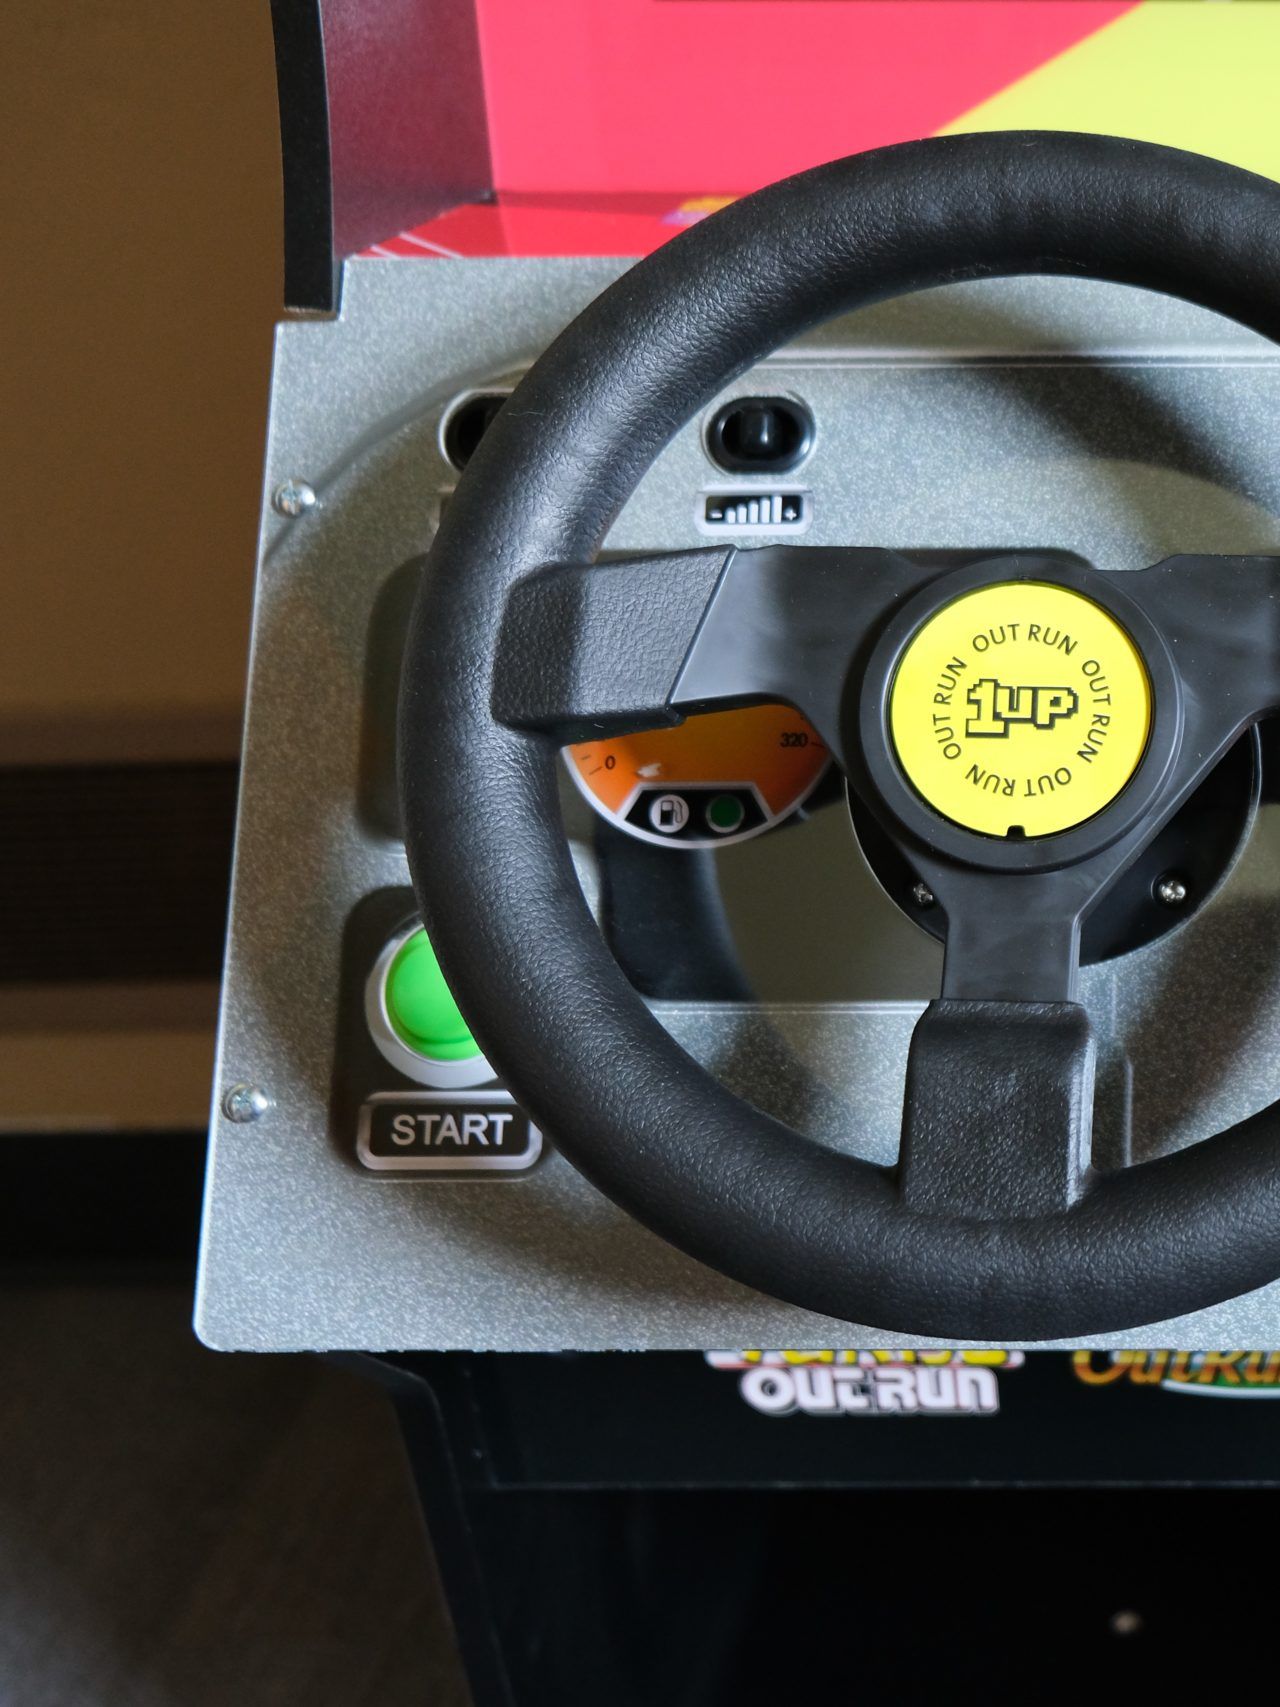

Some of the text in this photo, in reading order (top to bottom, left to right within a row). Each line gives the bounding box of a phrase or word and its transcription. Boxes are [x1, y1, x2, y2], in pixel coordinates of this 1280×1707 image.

[972, 624, 1078, 656] OUT RUN
[932, 656, 967, 760] OUT RUN
[1076, 660, 1111, 763] OUT RUN
[780, 732, 808, 748] 320
[604, 755, 616, 770] 0
[965, 764, 1072, 797] OUT RUN
[391, 1114, 513, 1146] START
